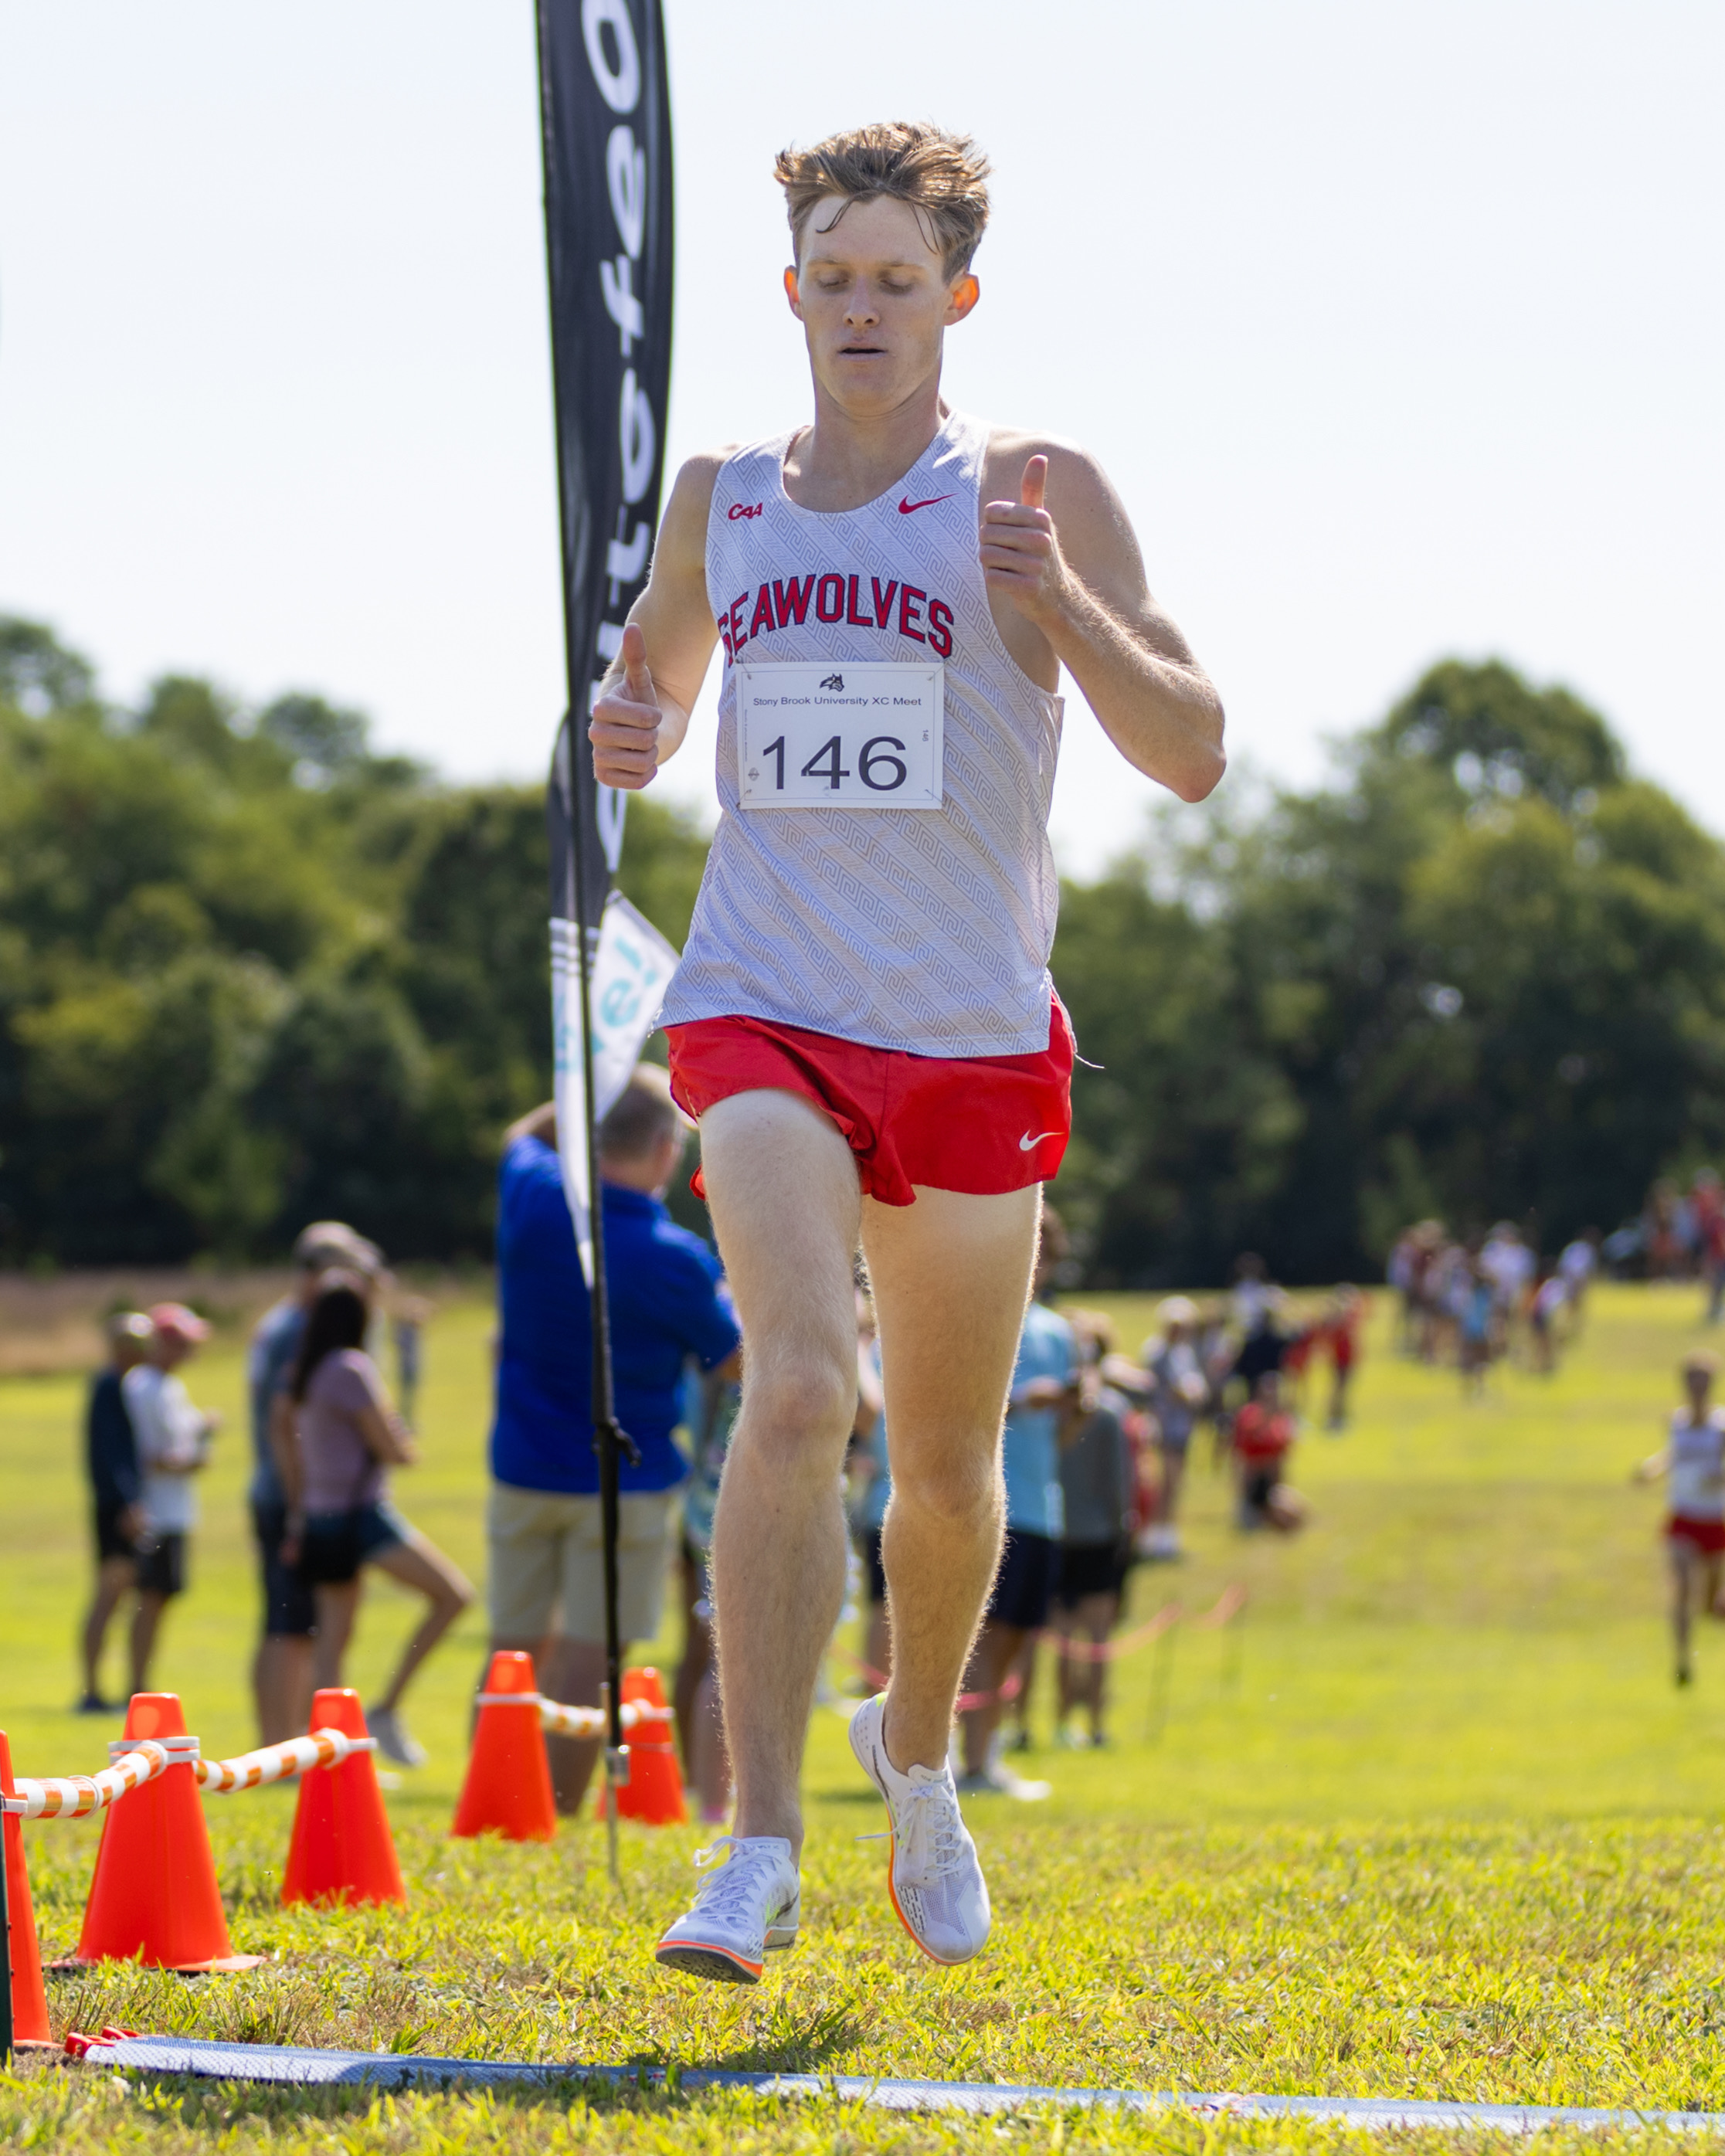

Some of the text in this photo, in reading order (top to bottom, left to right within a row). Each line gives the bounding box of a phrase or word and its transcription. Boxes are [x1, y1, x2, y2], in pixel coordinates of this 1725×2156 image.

[728, 503, 763, 521] CAA
[717, 573, 955, 669] SEAWOLVES
[752, 697, 922, 707] Stony Brook University XC Meet
[762, 735, 908, 791] 146
